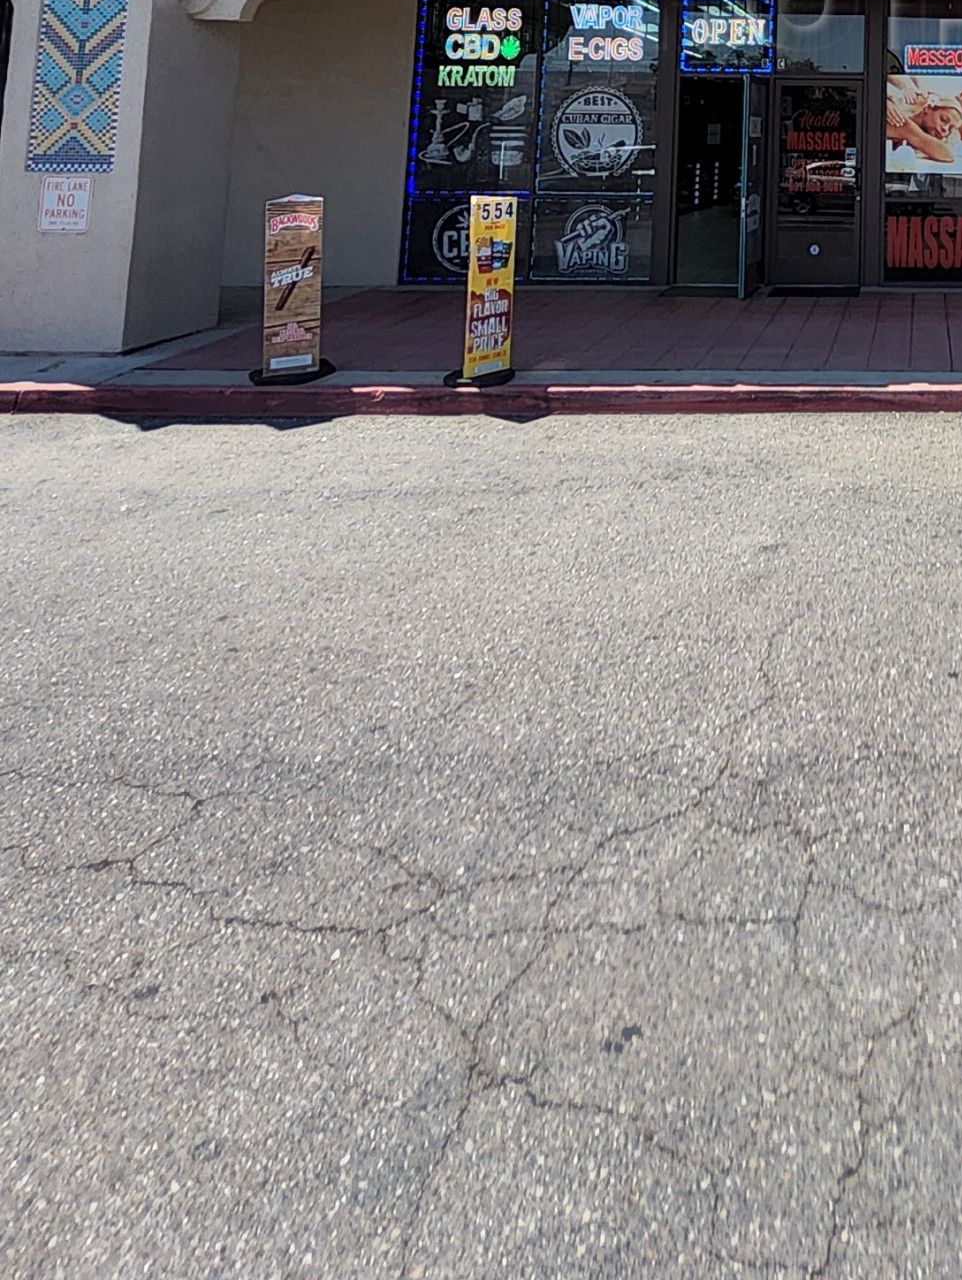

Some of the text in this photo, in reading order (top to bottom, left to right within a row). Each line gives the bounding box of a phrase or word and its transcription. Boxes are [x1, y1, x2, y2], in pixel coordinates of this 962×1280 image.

[446, 7, 522, 31] GLASS
[570, 4, 644, 29] VAPOR
[691, 18, 767, 46] OPEN
[445, 33, 501, 60] CBD
[568, 36, 644, 61] E-CIGS
[438, 65, 516, 87] KRATOM
[583, 95, 613, 107] BEST
[562, 114, 633, 124] CUBAN CIGAR
[786, 131, 847, 151] MASSAGE
[57, 193, 75, 207] NO
[44, 208, 85, 220] PARKING
[271, 213, 318, 234] BACKWOODS
[271, 266, 314, 288] TRUE
[473, 300, 509, 319] FLAVOR
[471, 316, 508, 338] SMALL
[473, 332, 504, 353] PRICE
